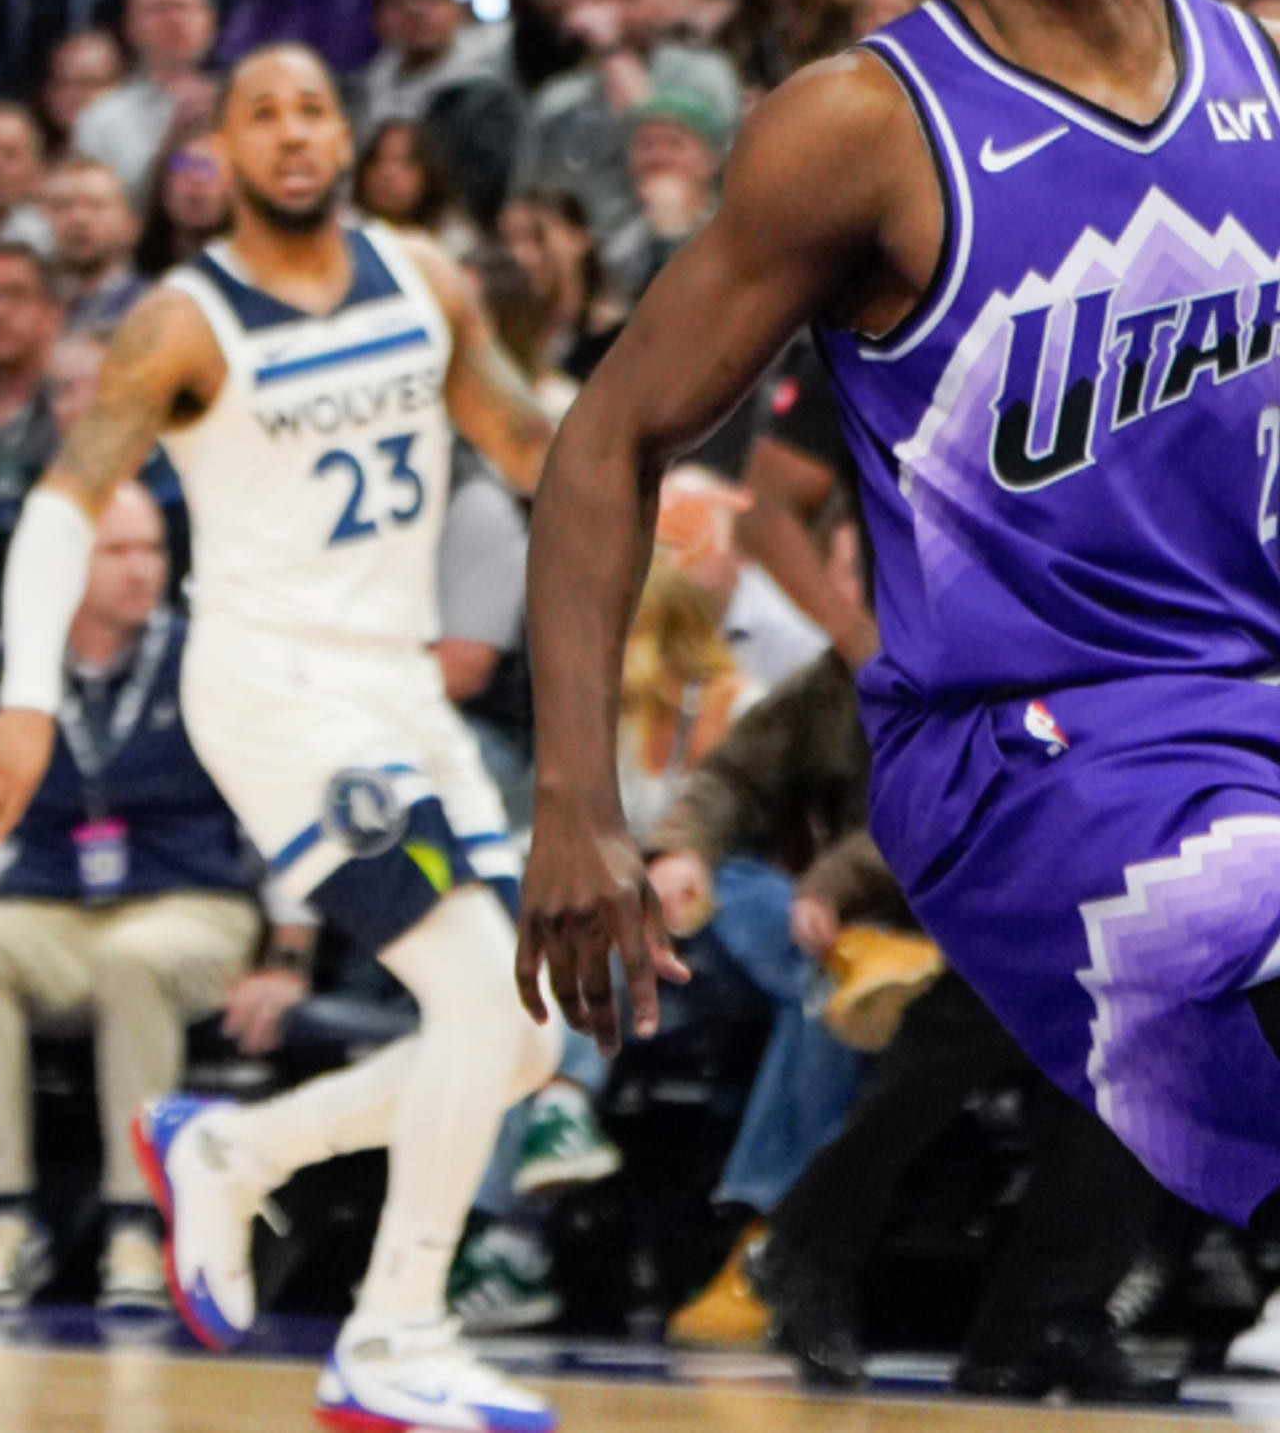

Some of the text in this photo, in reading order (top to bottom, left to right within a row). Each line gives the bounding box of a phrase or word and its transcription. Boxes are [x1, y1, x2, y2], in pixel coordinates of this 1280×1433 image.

[1206, 102, 1273, 141] LVT
[252, 366, 441, 444] WOLVES
[314, 431, 426, 549] 23
